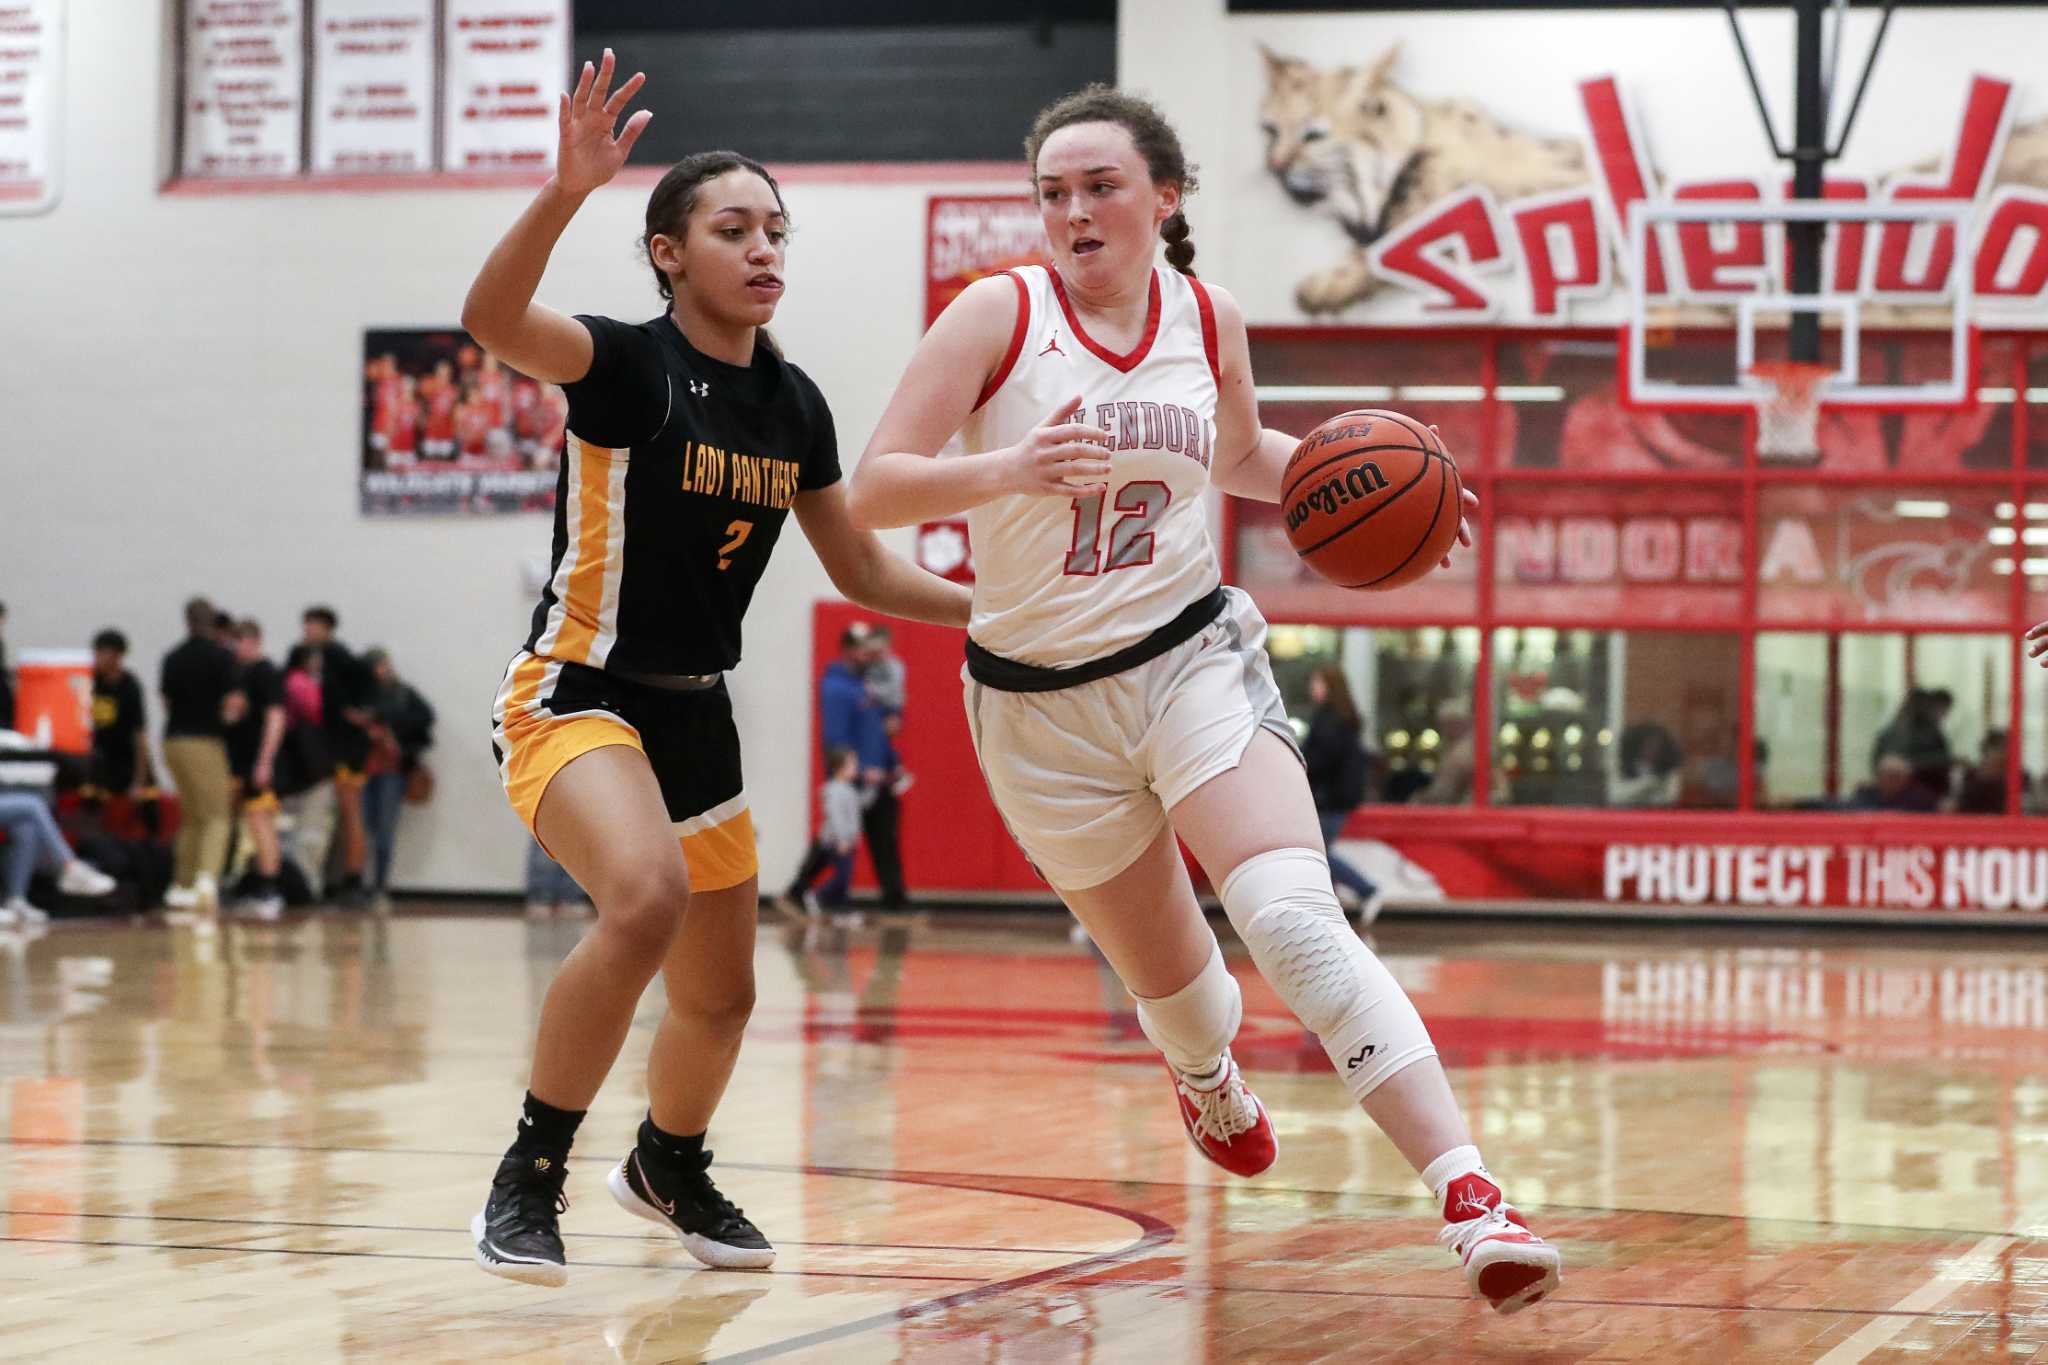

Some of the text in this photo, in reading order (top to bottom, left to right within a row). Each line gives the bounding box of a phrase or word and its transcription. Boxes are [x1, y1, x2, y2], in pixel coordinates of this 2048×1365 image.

[682, 440, 800, 510] LADY PANTHERS
[1286, 462, 1391, 533] Wilson
[716, 518, 754, 571] 2
[1063, 479, 1172, 576] 12
[1603, 845, 1833, 904] PROTECT
[1842, 846, 1937, 908] THIS
